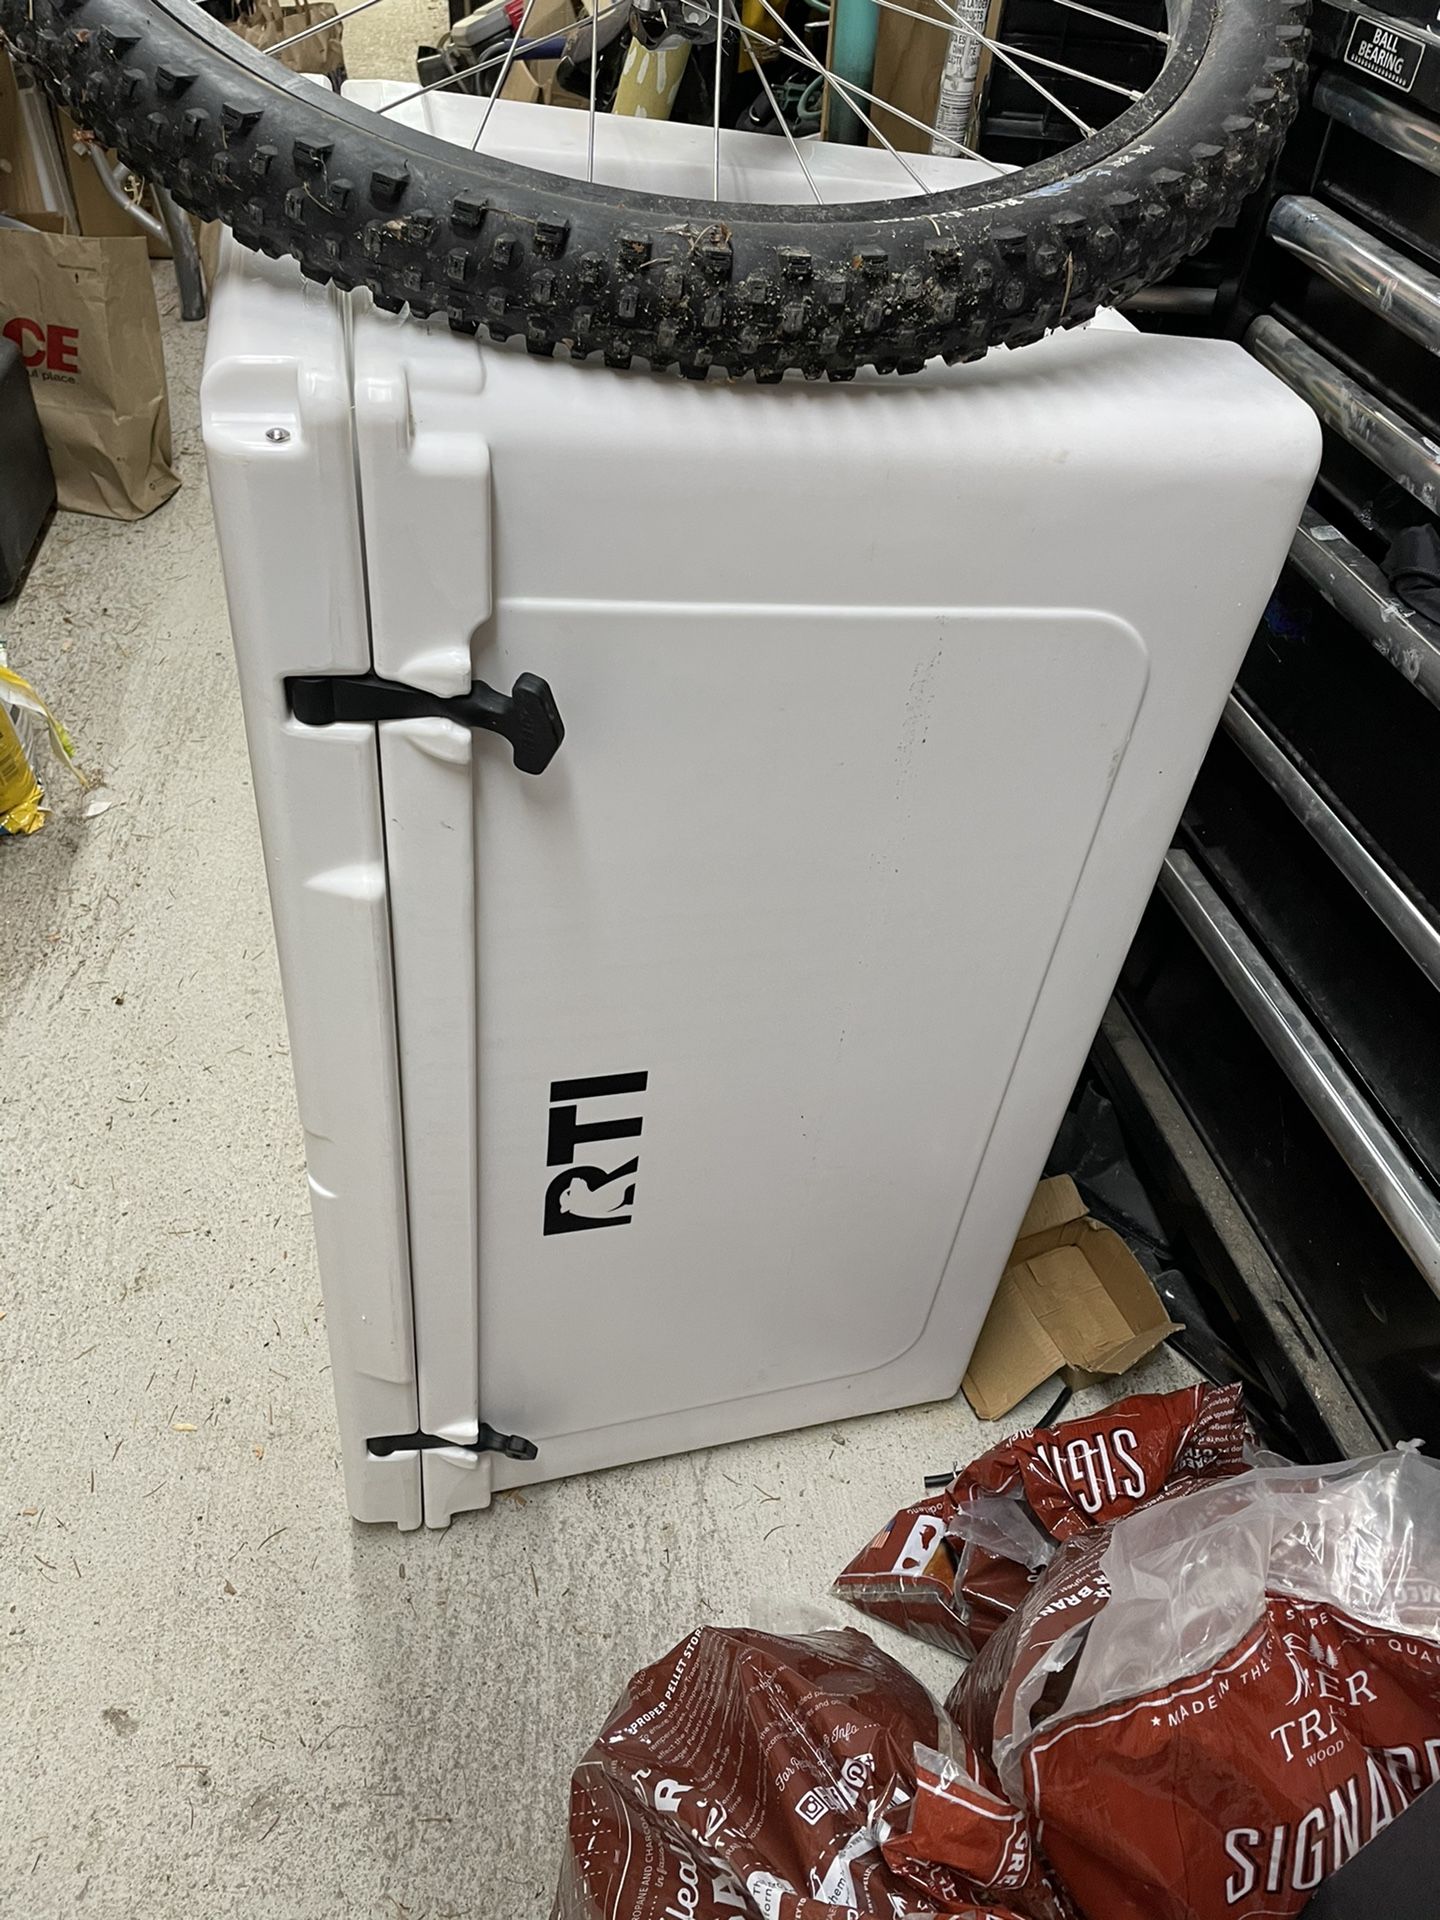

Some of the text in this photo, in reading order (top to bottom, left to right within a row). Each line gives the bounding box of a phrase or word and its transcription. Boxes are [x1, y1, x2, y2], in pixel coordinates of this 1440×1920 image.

[1358, 40, 1404, 74] BEARING
[1372, 28, 1399, 53] BALL
[3, 317, 79, 374] CE
[630, 1701, 668, 1730] PROPER
[664, 1658, 687, 1701] PELLET
[1168, 1659, 1270, 1727] MADE IN THE
[830, 1722, 860, 1743] Info
[1306, 1739, 1345, 1768] WOOD
[631, 1886, 650, 1920] ROPANE
[643, 1865, 654, 1888] AND
